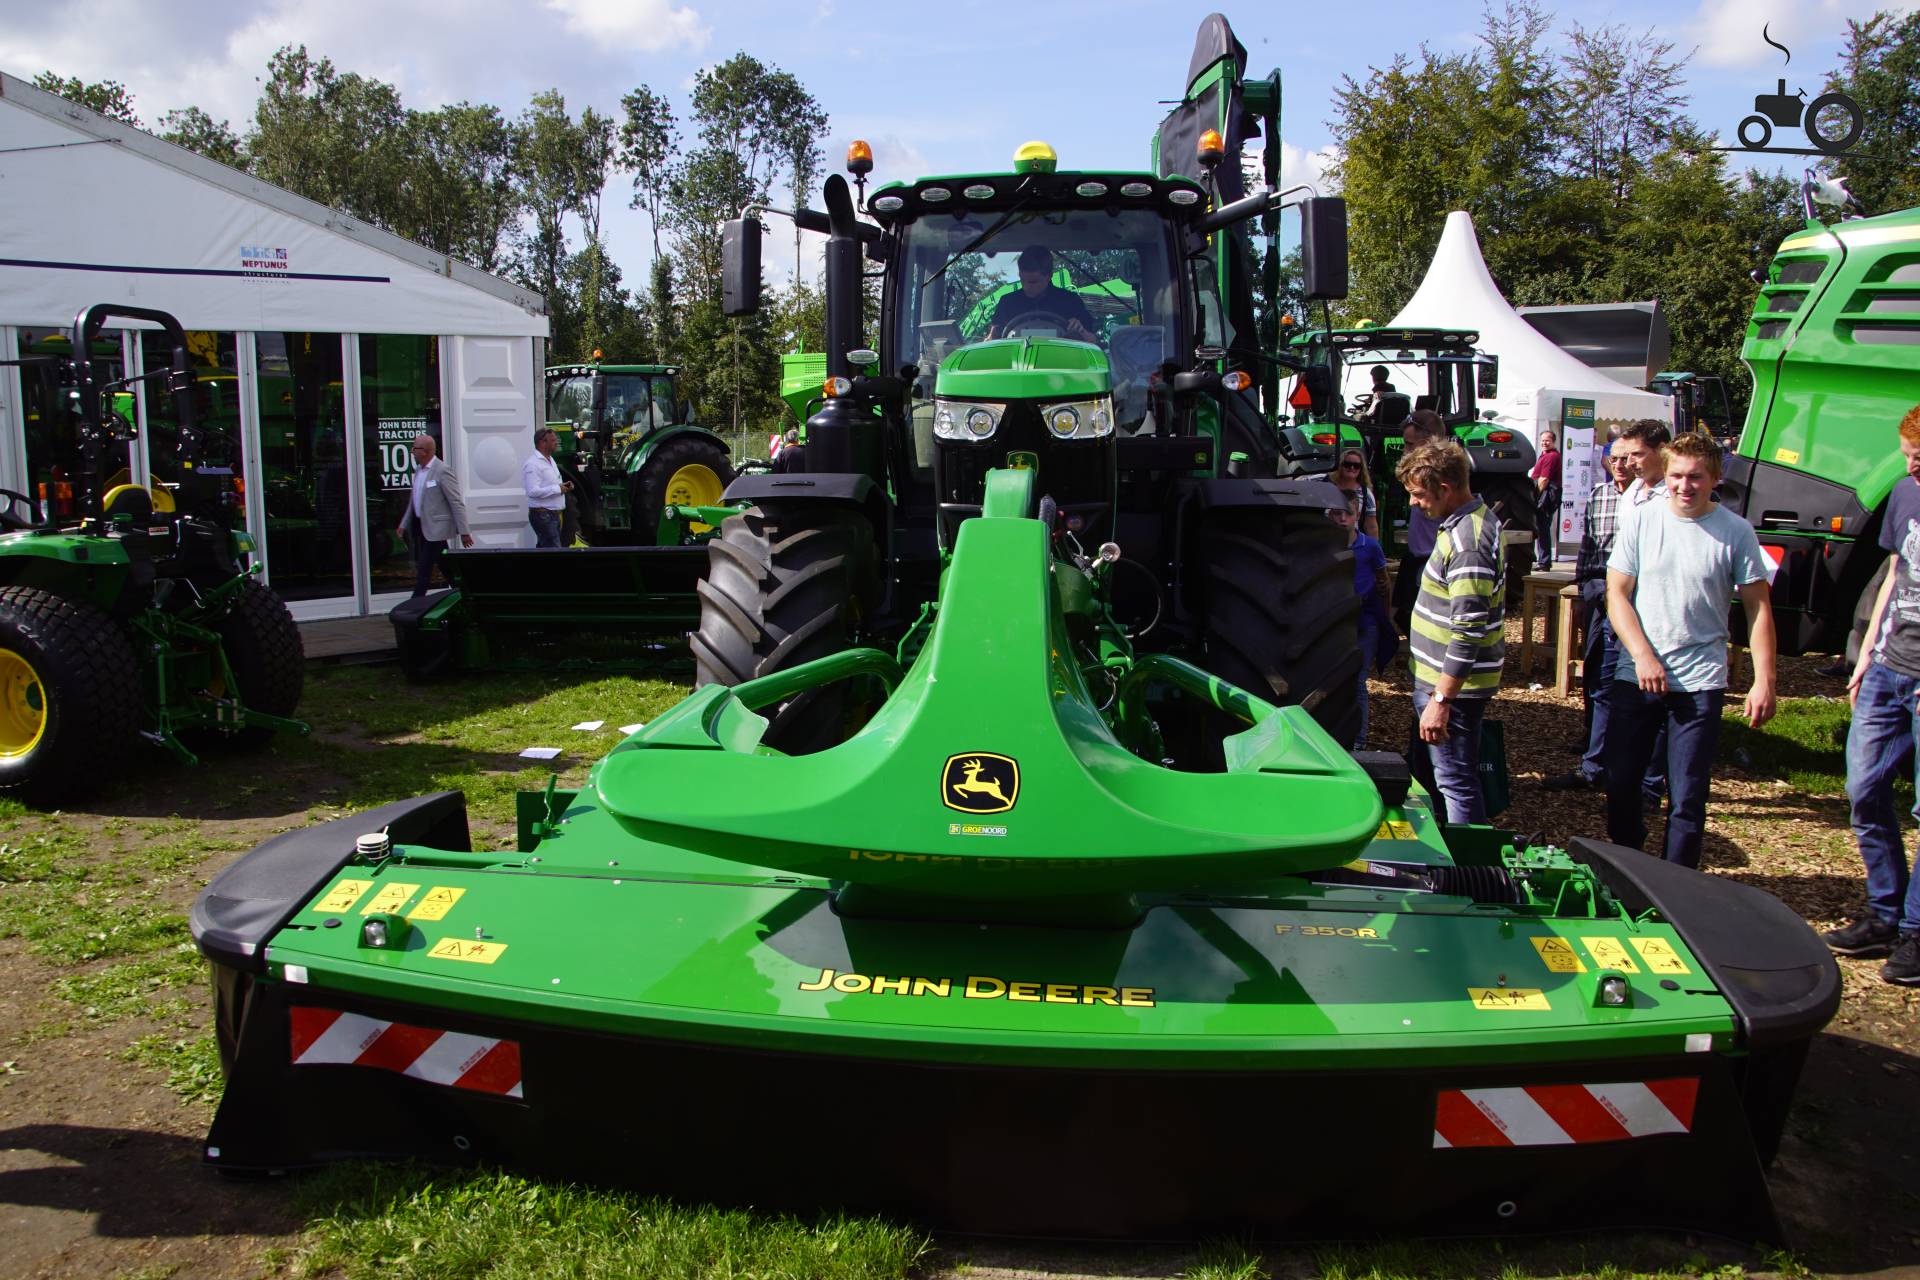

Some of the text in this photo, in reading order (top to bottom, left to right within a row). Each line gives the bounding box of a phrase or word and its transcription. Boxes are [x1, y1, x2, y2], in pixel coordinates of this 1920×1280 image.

[242, 260, 288, 269] NEPTUNUS
[378, 421, 427, 429] JOHN DEERE
[380, 473, 415, 487] YEA
[962, 826, 1008, 835] GROENOORD
[1275, 924, 1378, 939] F 350R
[798, 968, 1157, 1008] JOHN DEERE
